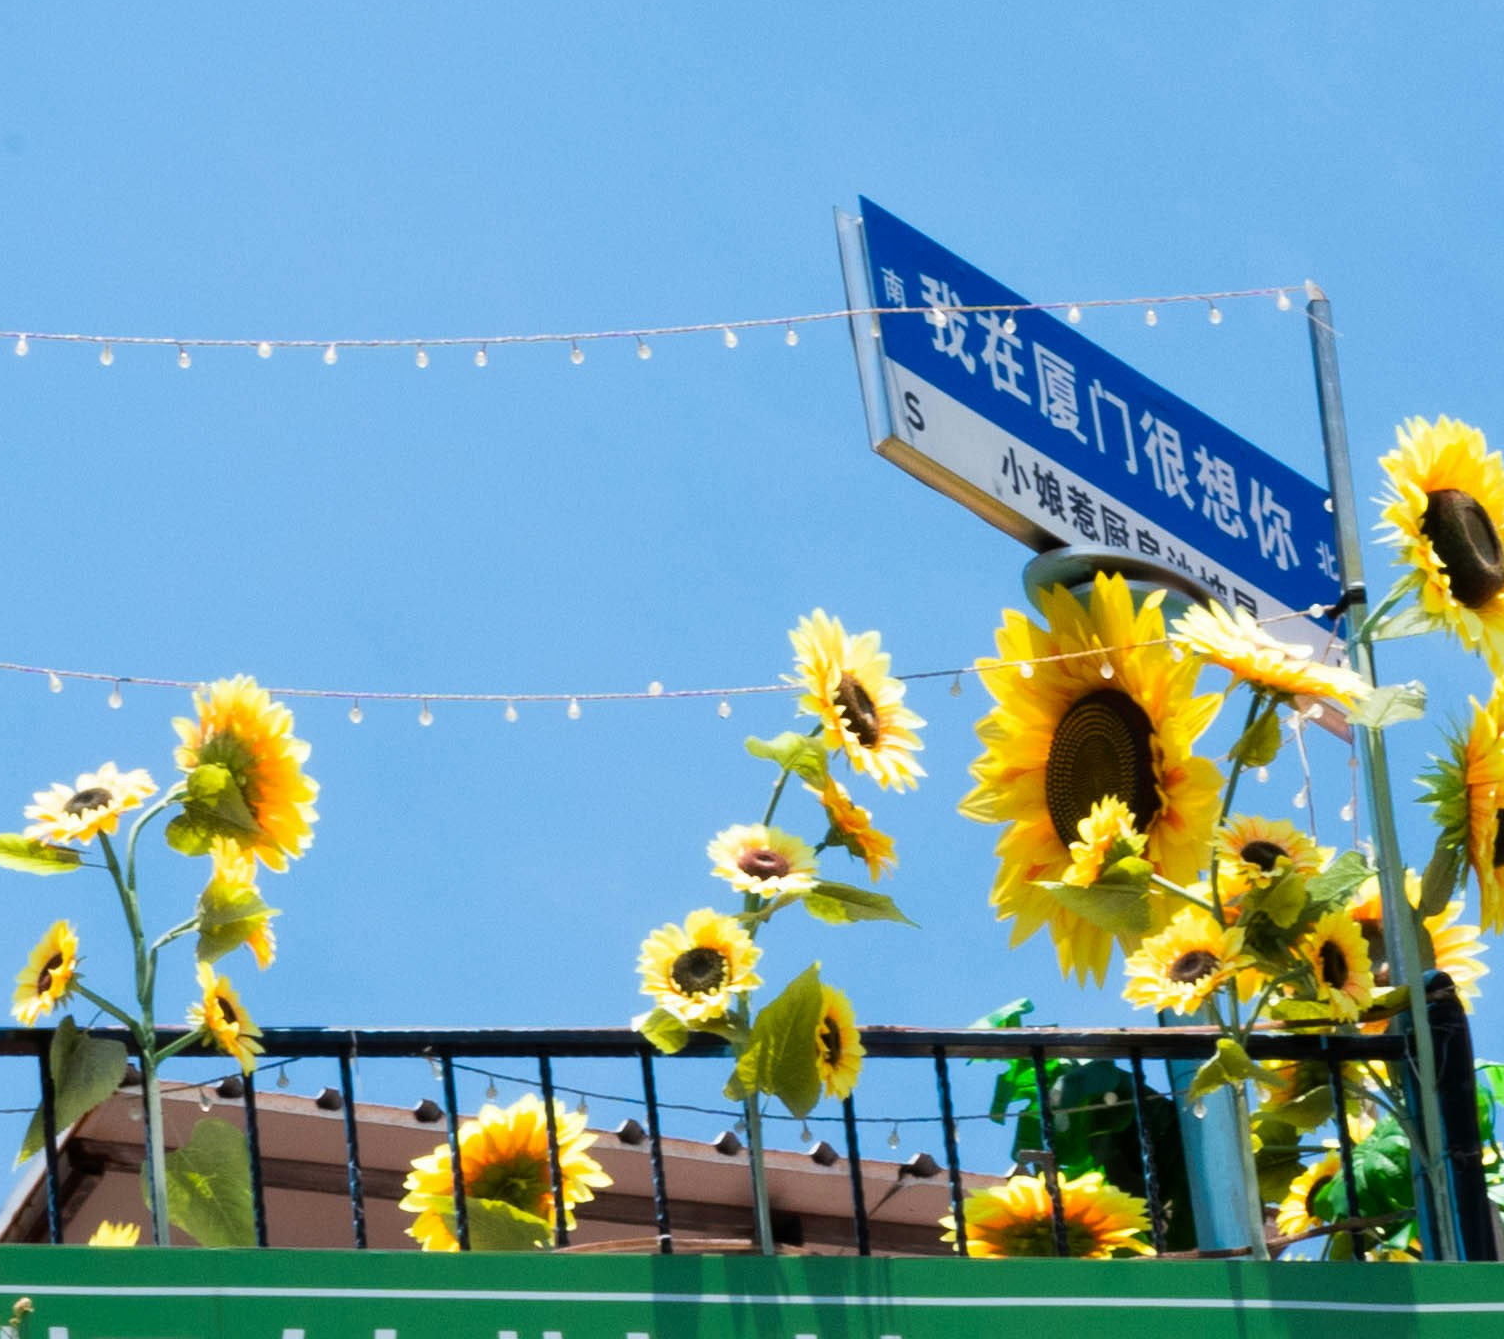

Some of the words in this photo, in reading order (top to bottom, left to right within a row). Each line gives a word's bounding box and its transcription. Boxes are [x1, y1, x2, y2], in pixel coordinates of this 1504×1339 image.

[880, 266, 907, 311] 南
[919, 272, 1302, 572] 我在厦门很想你
[1315, 540, 1341, 583] 北
[903, 390, 926, 432] S
